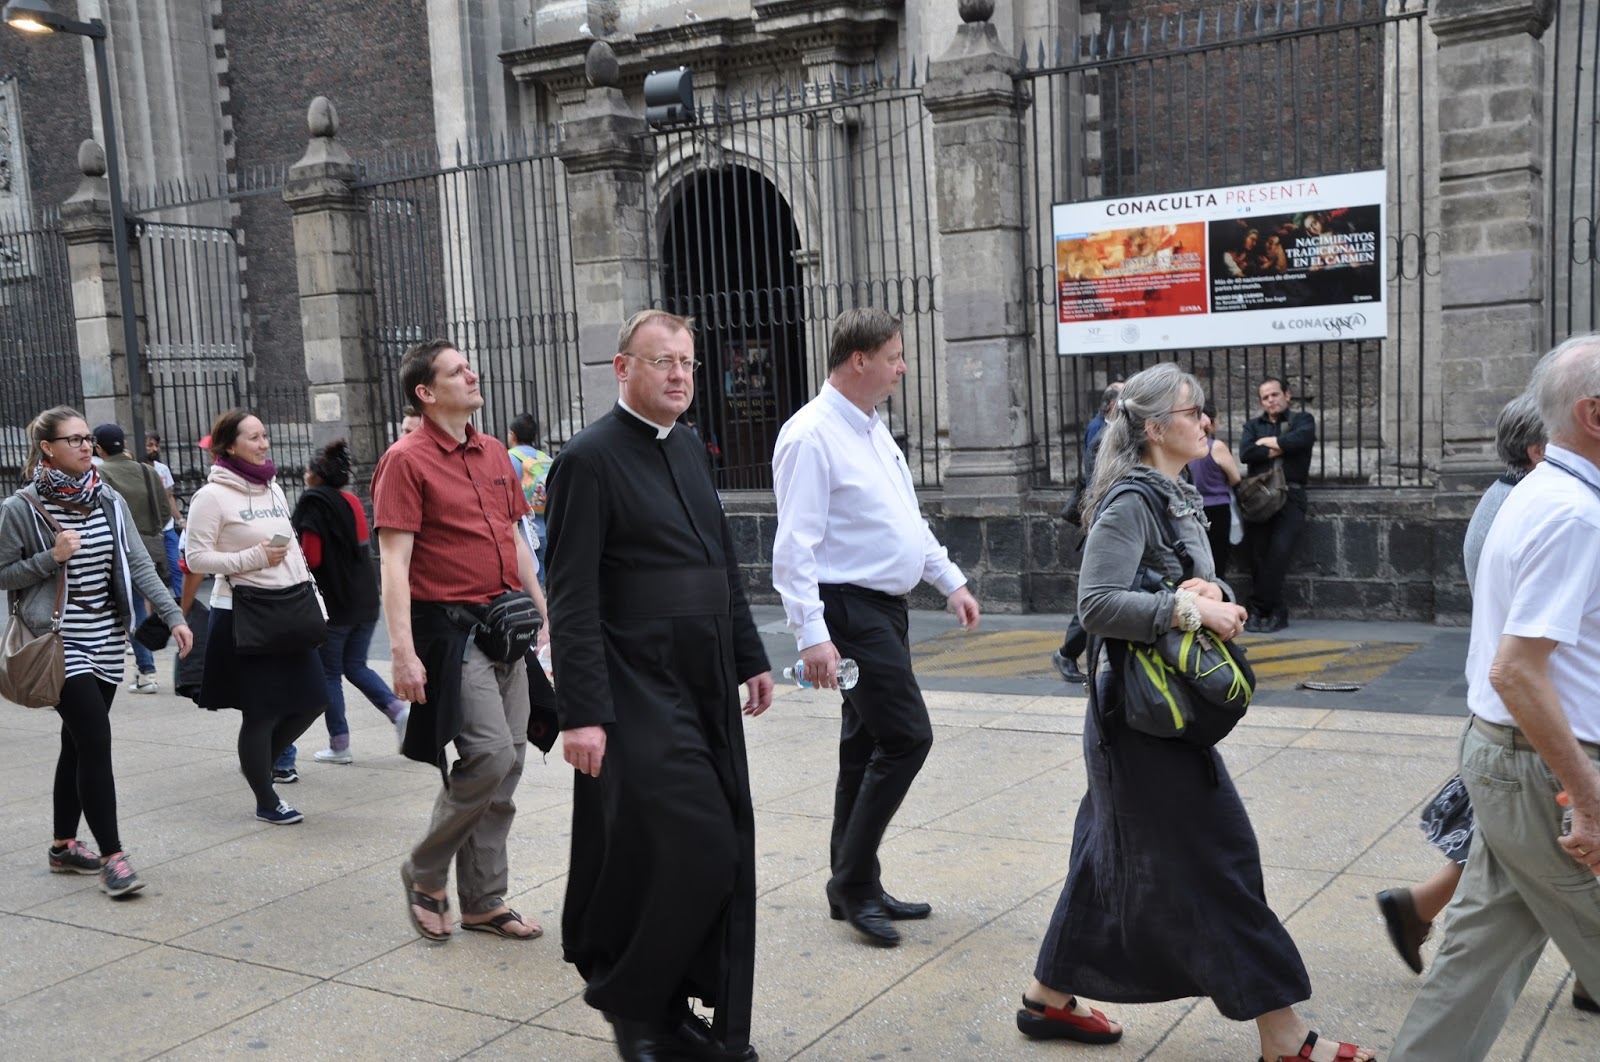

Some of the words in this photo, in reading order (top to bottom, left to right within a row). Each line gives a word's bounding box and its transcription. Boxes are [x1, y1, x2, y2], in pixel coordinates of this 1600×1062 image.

[1106, 193, 1218, 217] CONACULTA
[1226, 182, 1319, 205] PRESENTA
[1295, 231, 1375, 248] NACIMIENTOS
[1285, 242, 1375, 258] TRADICIONALES
[1293, 257, 1308, 268] EN
[1310, 256, 1324, 266] EL
[1325, 252, 1375, 264] CARMEN
